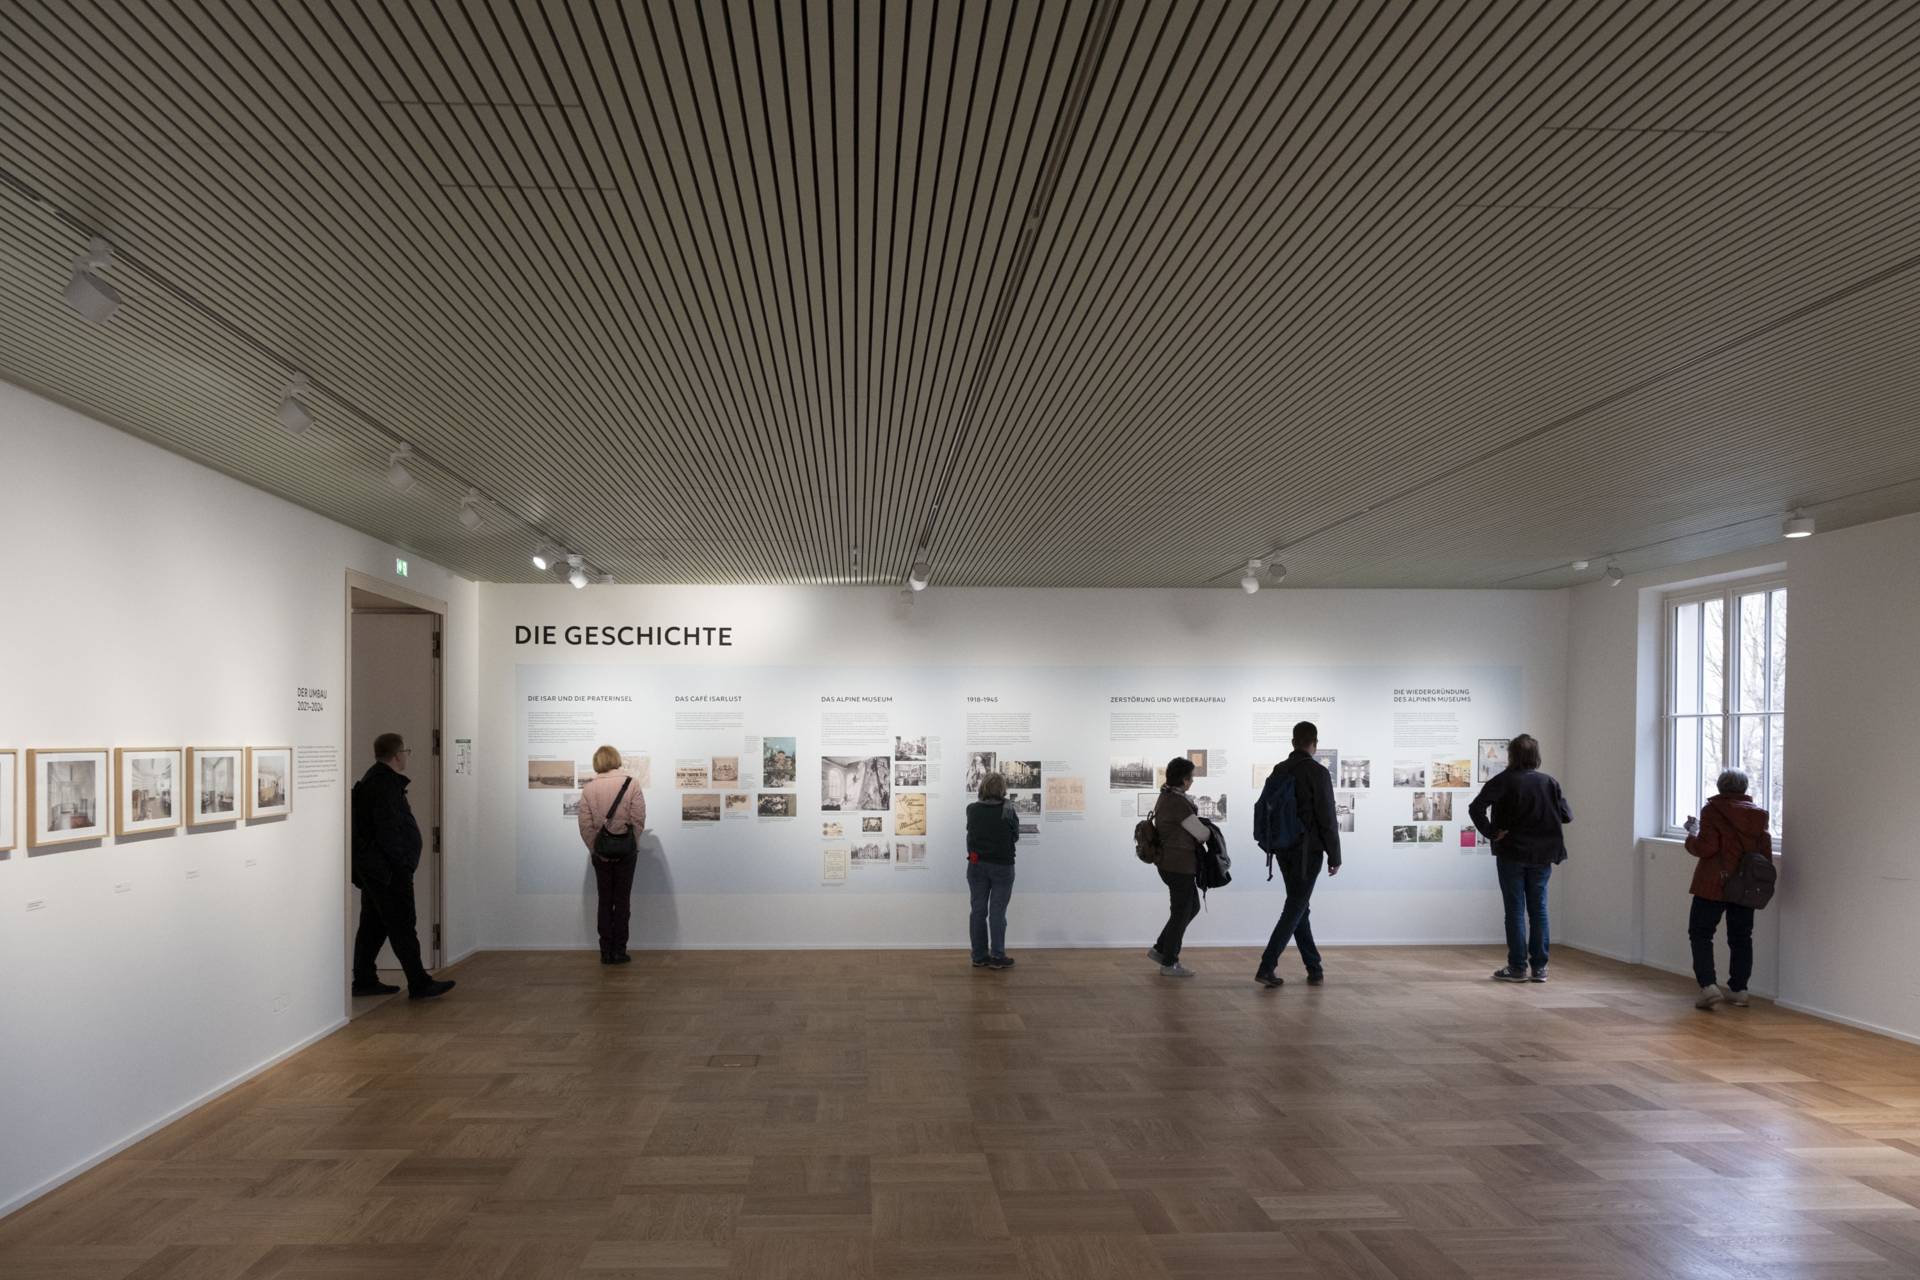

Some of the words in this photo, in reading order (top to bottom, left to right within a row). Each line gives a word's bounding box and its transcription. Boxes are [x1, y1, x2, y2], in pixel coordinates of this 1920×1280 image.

[515, 626, 556, 645] DIE
[564, 626, 732, 646] GESCHICHTE
[297, 687, 308, 697] DER
[309, 688, 328, 699] UMBAU
[1406, 687, 1470, 695] WIEDERGRÜNDUNG
[821, 695, 835, 703] DAS
[836, 695, 861, 703] ALPINE
[862, 695, 893, 703] MUSEUM
[1110, 695, 1155, 703] ZERSTÖRUNG
